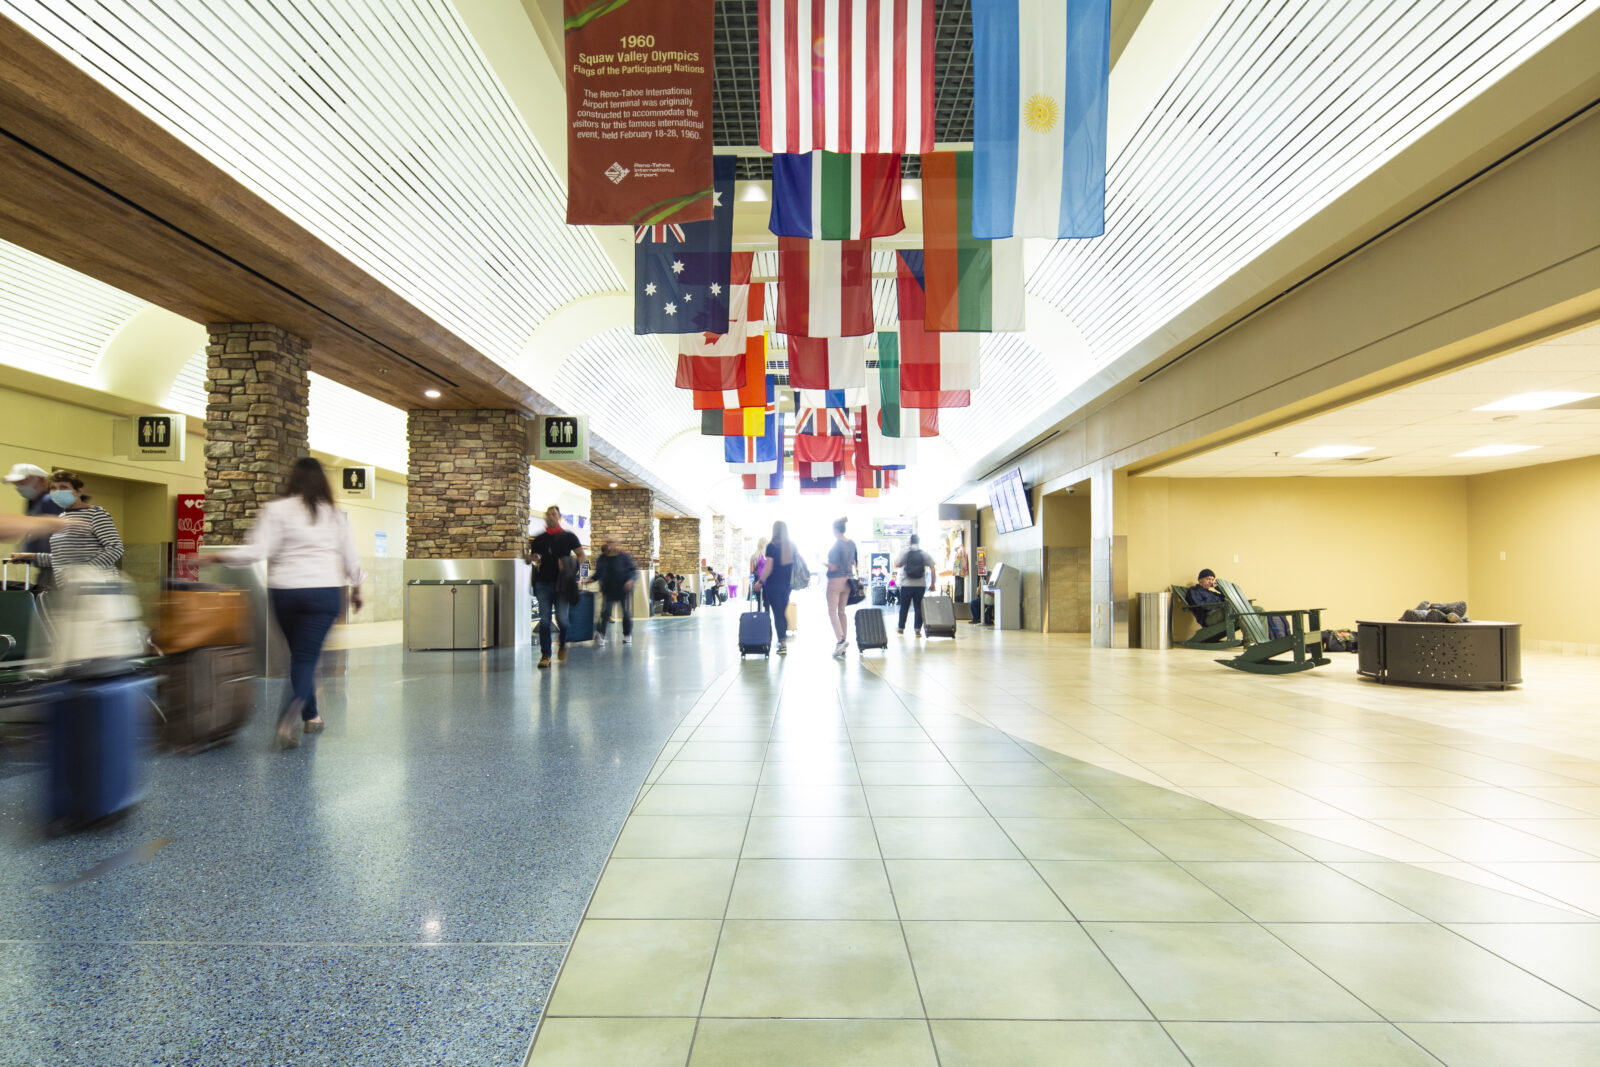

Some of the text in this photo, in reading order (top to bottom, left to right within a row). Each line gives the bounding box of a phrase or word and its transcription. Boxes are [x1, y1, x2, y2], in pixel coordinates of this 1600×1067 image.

[620, 35, 655, 49] 1960
[578, 50, 699, 66] Squaw Valley Olympics
[573, 63, 705, 78] Flags of the Participating Nations
[583, 86, 692, 99] The Reno-Tahoe International
[582, 97, 693, 109] Airport terminal was originally
[577, 108, 699, 119] constructed to accommodate the
[572, 118, 704, 129] visitors for this famous international
[577, 129, 701, 140] event, held February 18-28, 1960.
